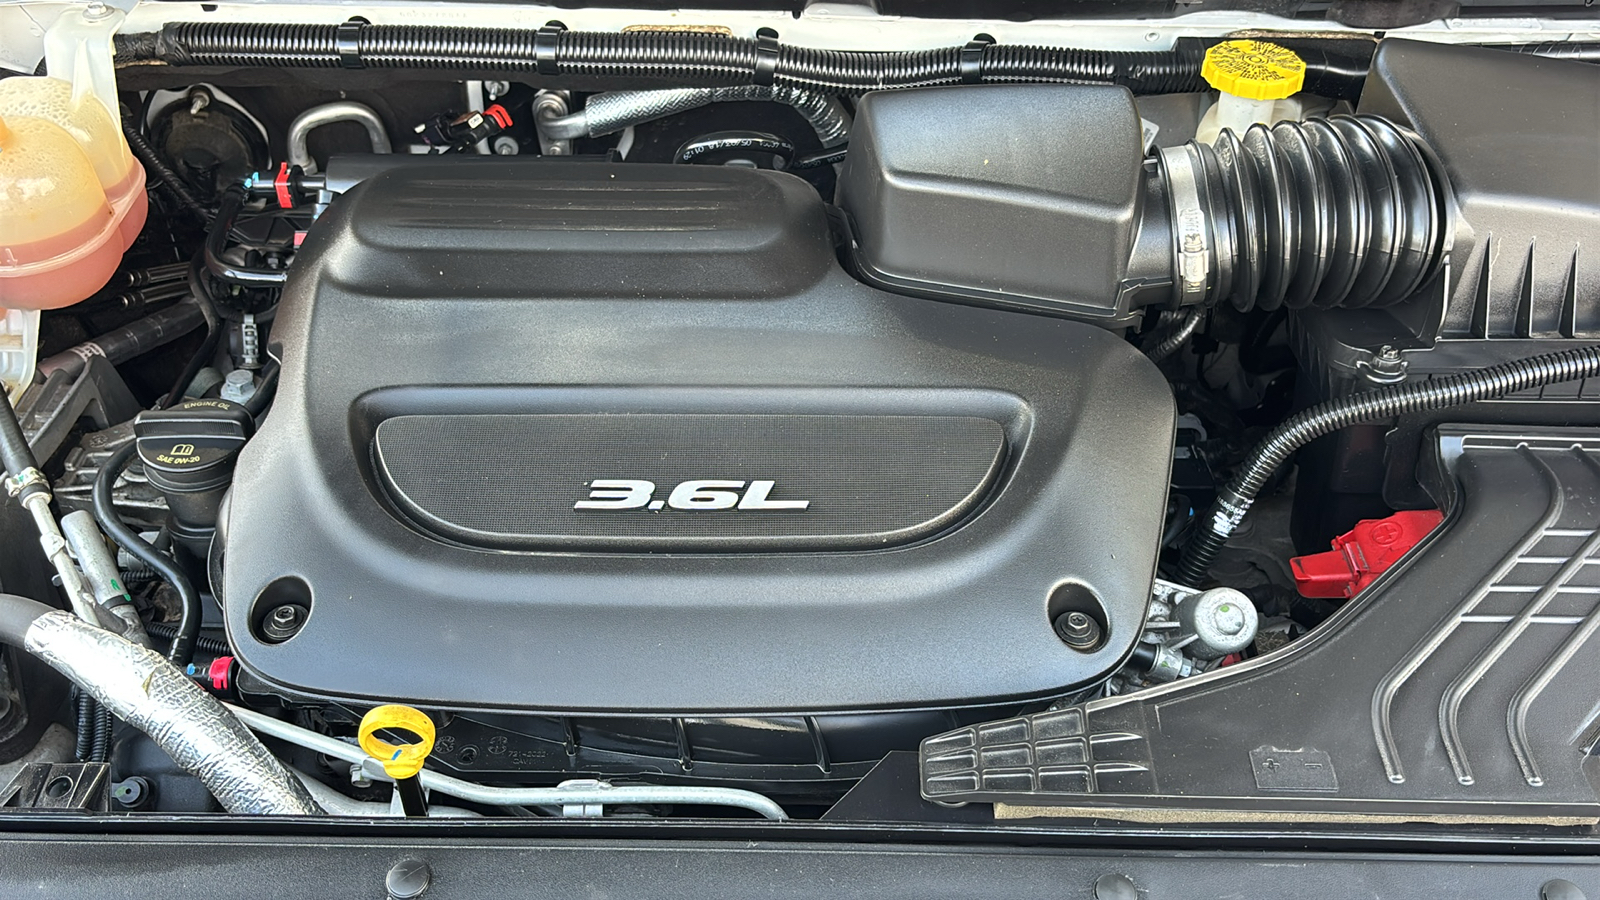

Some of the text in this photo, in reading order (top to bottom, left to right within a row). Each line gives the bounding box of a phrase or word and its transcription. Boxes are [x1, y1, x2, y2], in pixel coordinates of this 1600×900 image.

[184, 401, 231, 411] ENGINE OIL
[156, 454, 201, 464] SAE 0W-20
[574, 479, 810, 511] 3.6L
